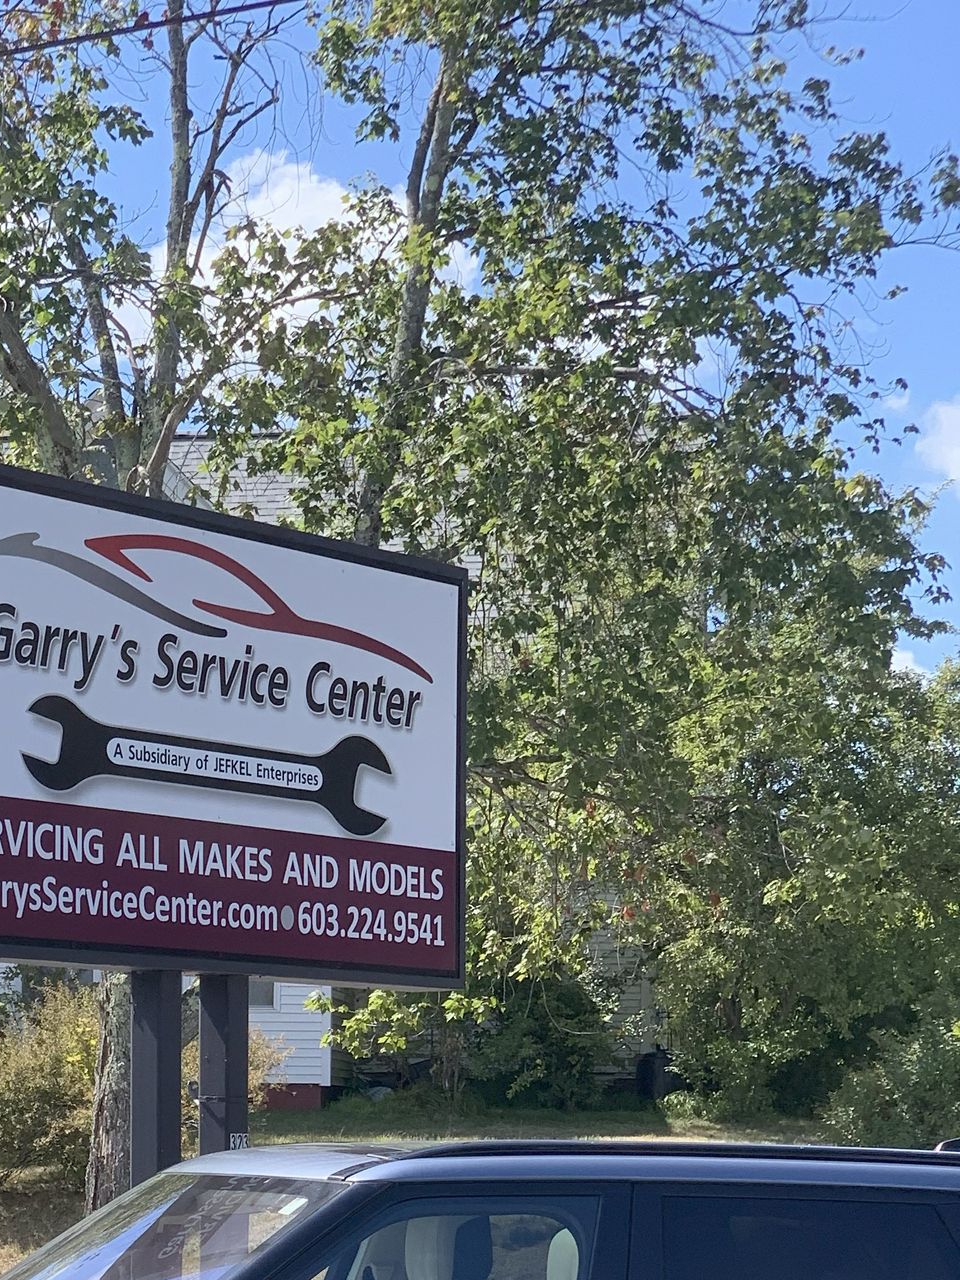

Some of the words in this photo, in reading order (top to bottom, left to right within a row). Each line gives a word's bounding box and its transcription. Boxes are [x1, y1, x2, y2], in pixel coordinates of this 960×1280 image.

[152, 633, 289, 706] Service
[305, 661, 422, 728] Center
[113, 743, 124, 759] A
[128, 745, 190, 772] Subsidiary
[195, 755, 209, 771] of
[213, 757, 252, 777] JEFKEL
[256, 763, 319, 787] Enterprises
[116, 832, 168, 872] ALL
[178, 838, 272, 883] MAKES
[282, 851, 339, 889] AND
[348, 858, 444, 901] MODELS
